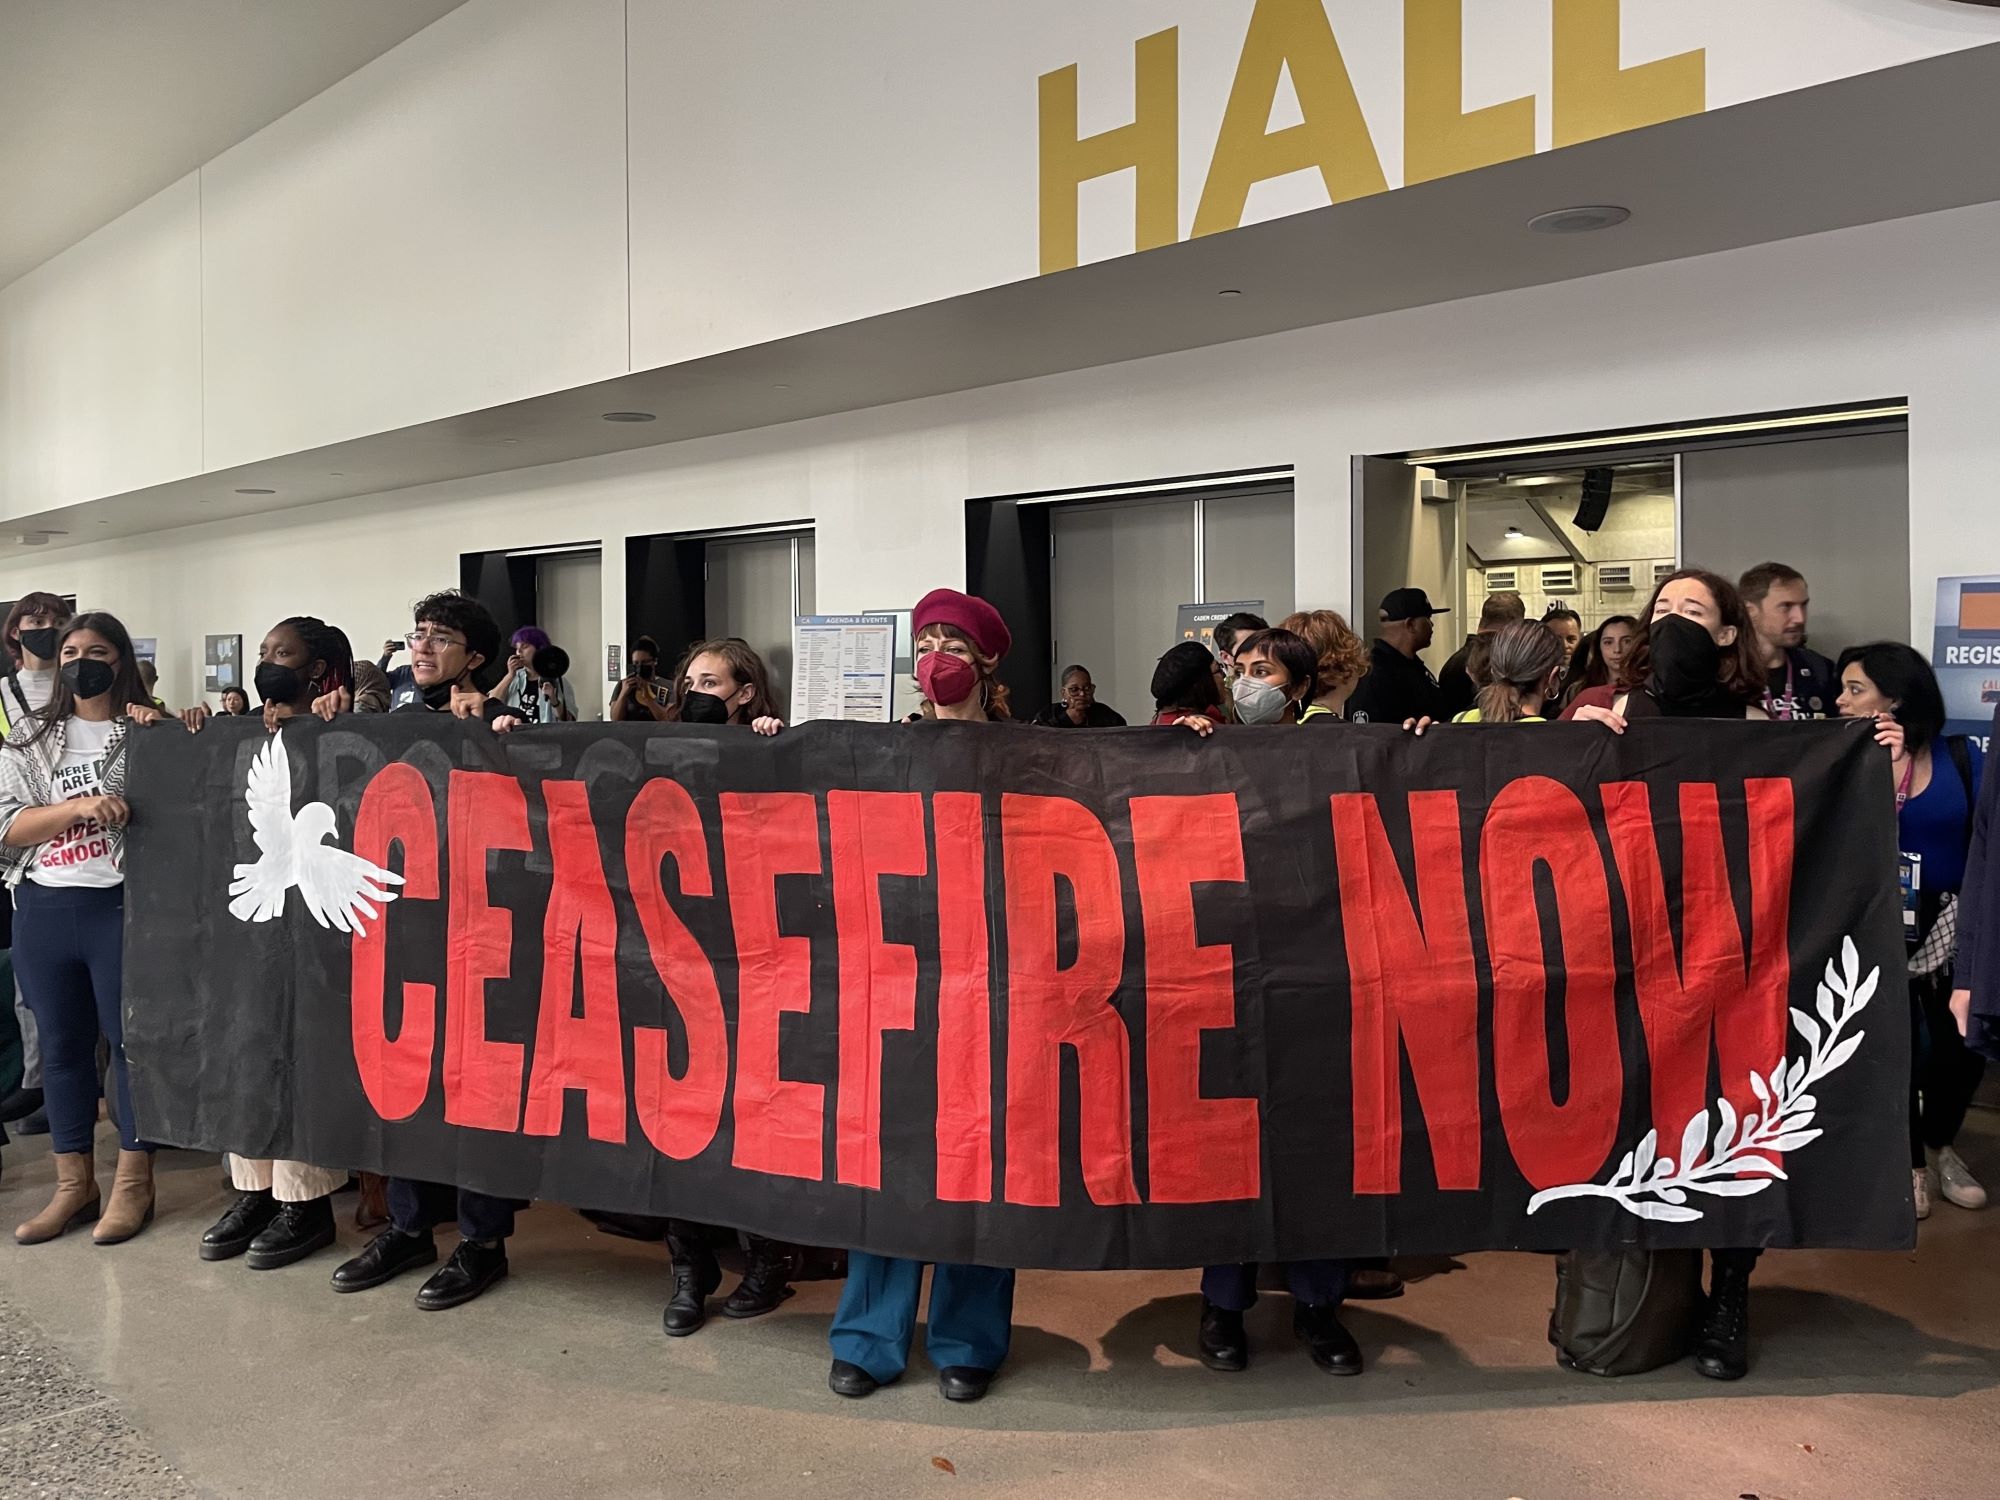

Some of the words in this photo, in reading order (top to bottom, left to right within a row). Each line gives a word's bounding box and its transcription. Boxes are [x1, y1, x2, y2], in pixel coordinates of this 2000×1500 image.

[1038, 0, 1706, 276] HALL
[1945, 646, 2000, 665] REGIS
[62, 773, 94, 793] ARE
[351, 762, 1261, 1206] CEASEFIRE
[1331, 776, 1795, 1195] NOW
